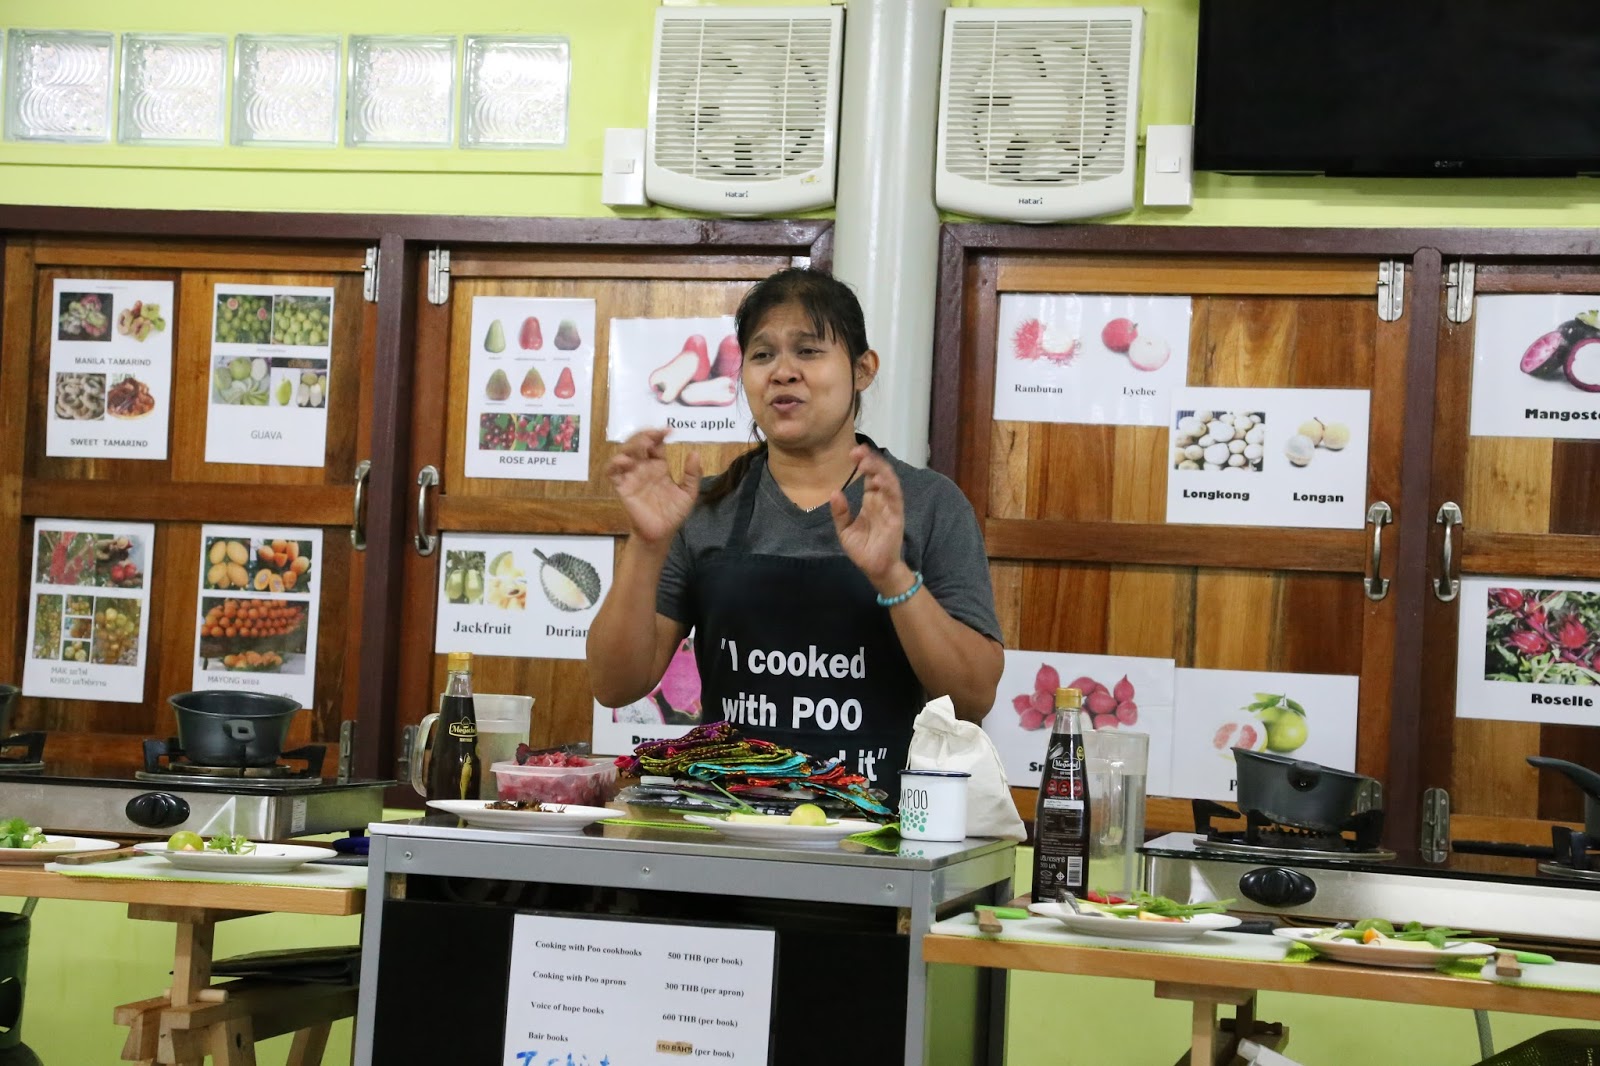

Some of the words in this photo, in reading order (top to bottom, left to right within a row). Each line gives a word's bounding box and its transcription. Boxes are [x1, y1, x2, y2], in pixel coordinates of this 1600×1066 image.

[725, 190, 748, 198] Hatari
[1018, 197, 1043, 205] Hatari
[75, 357, 105, 365] MANILA
[108, 358, 151, 366] TAMARIND
[1014, 384, 1063, 394] Rambutan
[1123, 386, 1156, 397] Lychee
[1525, 408, 1600, 421] Mangost
[666, 417, 697, 429] Rose
[700, 417, 736, 431] apple
[250, 429, 283, 440] GUAVA
[70, 438, 98, 446] SWEET
[103, 439, 148, 447] TAMARIND
[499, 456, 525, 464] ROSE
[527, 457, 557, 465] APPLE
[1183, 489, 1250, 501] Longkong
[1293, 492, 1344, 503] Longan
[453, 621, 511, 635] Jackfruit
[748, 645, 866, 679] cooked
[1531, 693, 1594, 707] Roselle
[721, 692, 777, 728] with
[791, 696, 863, 731] POO
[535, 940, 567, 951] Cooking
[568, 944, 585, 952] with
[587, 945, 601, 953] Poo
[602, 947, 642, 956] cookbooks
[668, 952, 681, 960] 500
[683, 953, 702, 962] THB
[703, 956, 719, 964] (per
[721, 957, 743, 966] book)
[532, 970, 564, 981] Cooking
[566, 974, 583, 982] with
[585, 975, 599, 983] Poo
[600, 978, 627, 986] aprons
[665, 982, 679, 990] 300
[680, 984, 699, 992] THB
[700, 986, 716, 995] (per
[718, 989, 744, 997] apron)
[531, 1001, 551, 1010] Voice
[553, 1003, 561, 1011] of
[562, 1004, 581, 1013] hope
[582, 1006, 604, 1014] books
[662, 1013, 676, 1021] 600
[678, 1014, 696, 1023] THB
[698, 1017, 714, 1026] (per
[716, 1018, 738, 1028] book)
[528, 1032, 544, 1040] Bair
[546, 1034, 568, 1042] books
[694, 1048, 710, 1057] (per
[713, 1049, 735, 1059] book)
